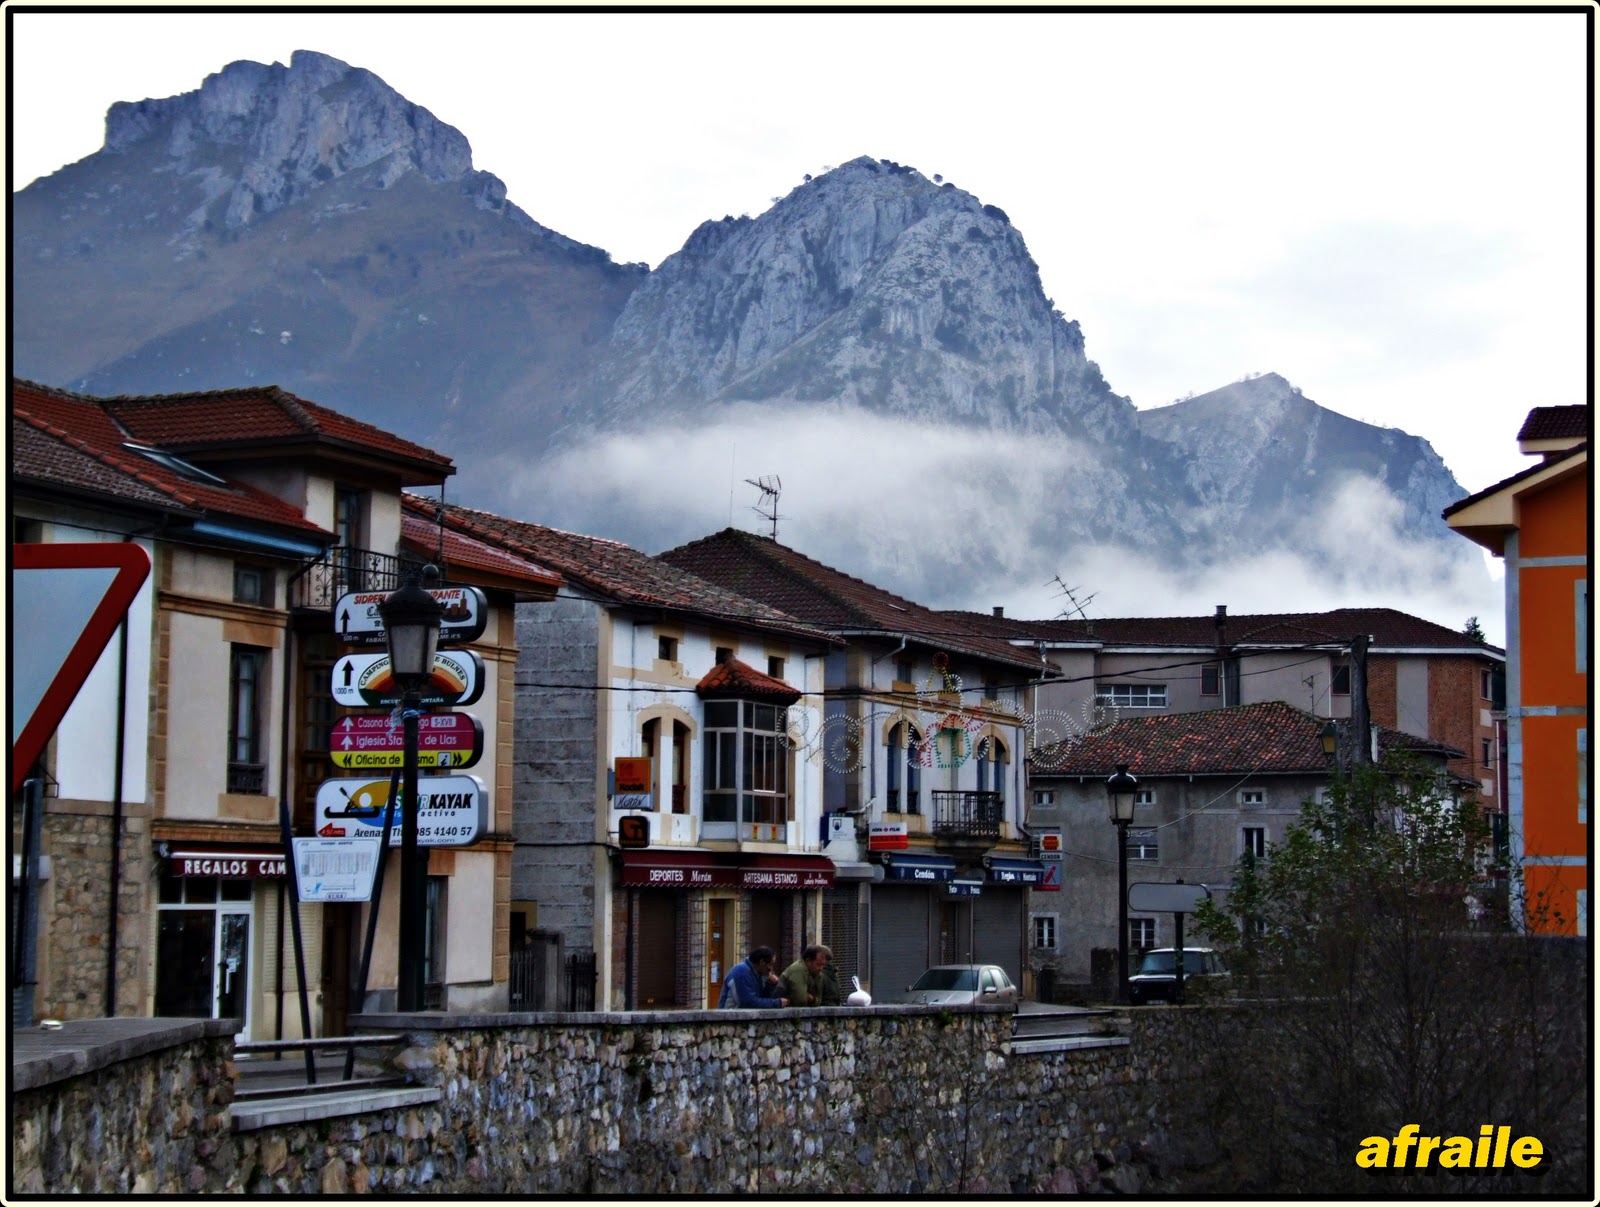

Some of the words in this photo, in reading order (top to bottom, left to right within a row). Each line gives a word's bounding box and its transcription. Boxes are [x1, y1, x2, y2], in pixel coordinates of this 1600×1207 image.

[361, 661, 389, 686] CAMPING
[441, 658, 466, 681] BULNES
[356, 735, 386, 749] Iglesia
[424, 734, 437, 746] de
[439, 734, 457, 745] Llas
[355, 754, 387, 765] Oficina
[388, 755, 400, 764] de
[619, 783, 645, 791] Kodak
[434, 827, 457, 836] 4140
[460, 827, 473, 836] 57
[184, 860, 247, 875] REGALOS
[649, 869, 684, 882] DEPORTES
[774, 873, 798, 884] ESTANCO
